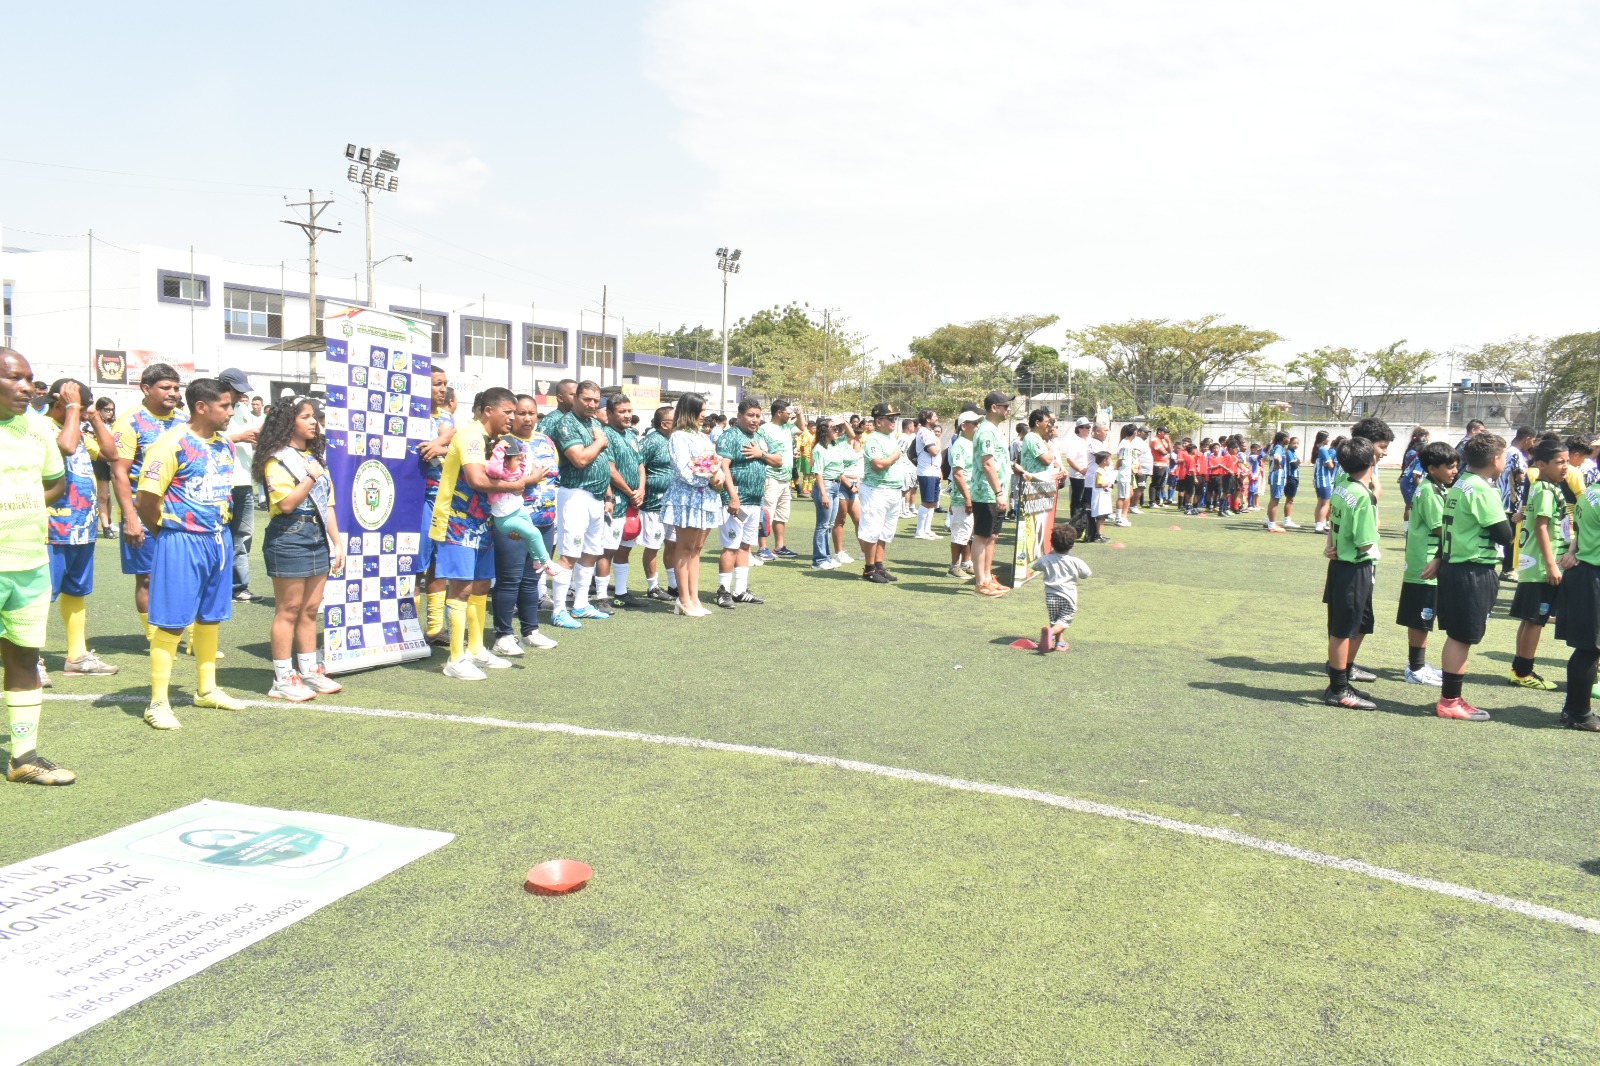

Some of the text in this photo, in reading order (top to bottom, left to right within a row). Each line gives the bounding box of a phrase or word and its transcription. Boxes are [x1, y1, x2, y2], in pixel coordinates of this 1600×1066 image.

[86, 861, 130, 875] DE
[80, 873, 156, 904] SINAÍ
[97, 885, 181, 920] DEPORTIVO
[27, 931, 112, 968] REALIDAD
[107, 921, 138, 934] DE
[130, 905, 173, 923] DIOS
[55, 910, 206, 977] Acuerdo ministerial
[48, 983, 141, 1024] Teléfono:
